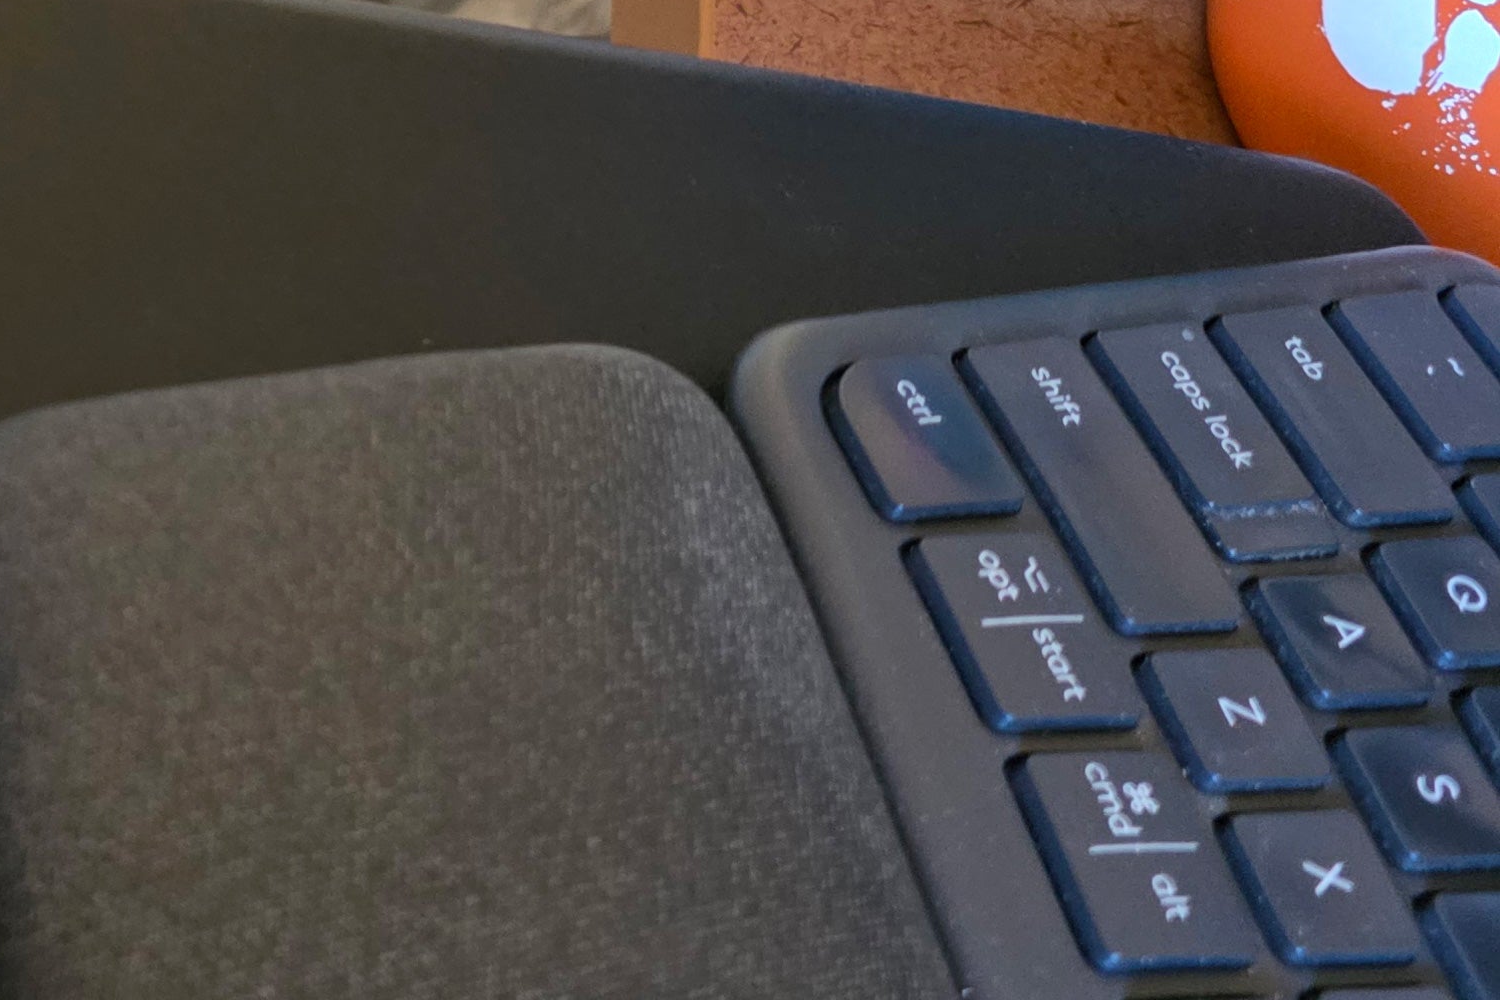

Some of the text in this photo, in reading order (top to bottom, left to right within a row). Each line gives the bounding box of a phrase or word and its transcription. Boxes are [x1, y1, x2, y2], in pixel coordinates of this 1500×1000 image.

[1285, 335, 1323, 381] tab
[897, 379, 943, 426] ctrl
[1032, 366, 1081, 427] shift
[1161, 351, 1252, 469] caps lock
[978, 550, 1019, 602] opt
[1447, 574, 1488, 613] Q
[1323, 614, 1366, 649] A
[1032, 628, 1086, 702] start
[1217, 696, 1266, 728] Z
[1085, 762, 1143, 837] cmd
[1417, 773, 1461, 804] S
[1152, 873, 1191, 922] alt
[1302, 860, 1355, 896] X
